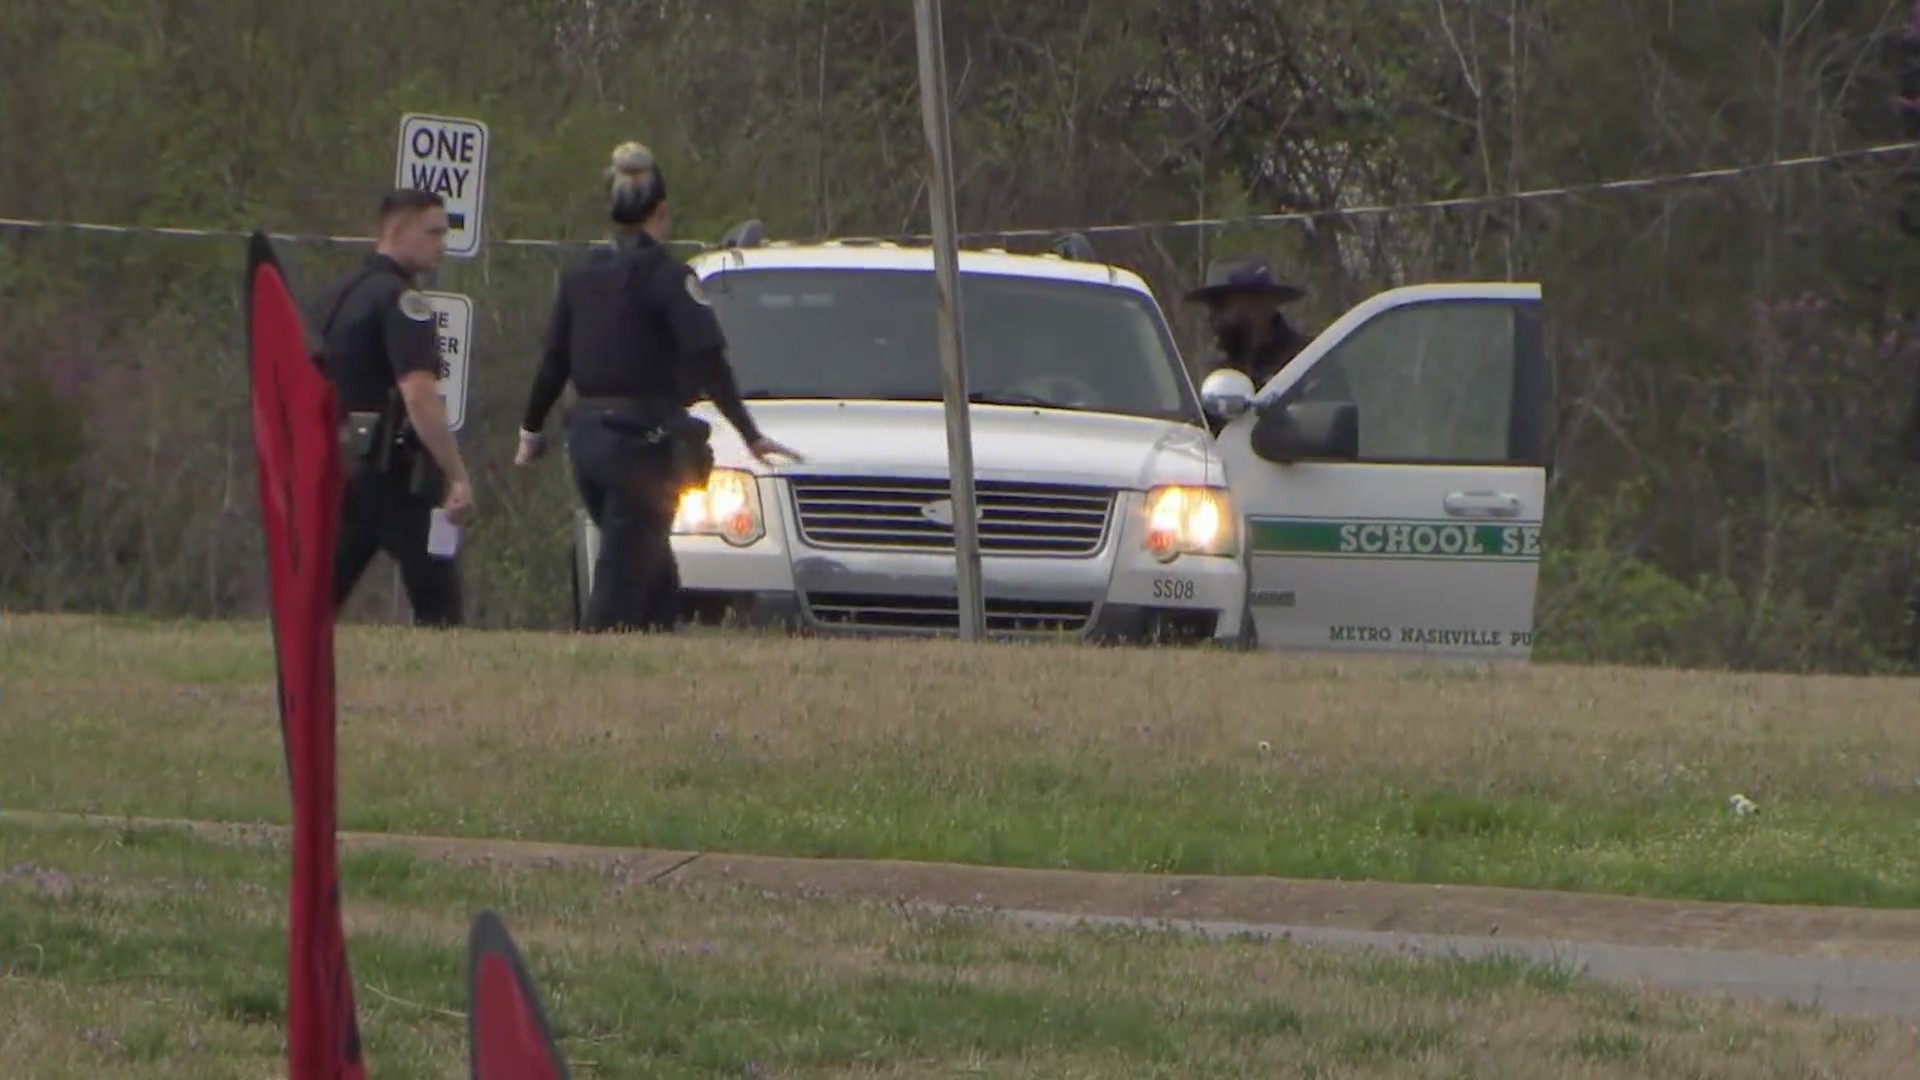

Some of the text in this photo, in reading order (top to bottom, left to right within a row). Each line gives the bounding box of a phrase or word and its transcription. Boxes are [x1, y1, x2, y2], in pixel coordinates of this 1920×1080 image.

[412, 127, 475, 163] ONE
[411, 163, 469, 198] WAY
[1340, 524, 1483, 554] SCHOOL
[1153, 579, 1195, 600] SS08
[1329, 625, 1392, 642] METRO
[1401, 628, 1502, 646] NASHVILLE
